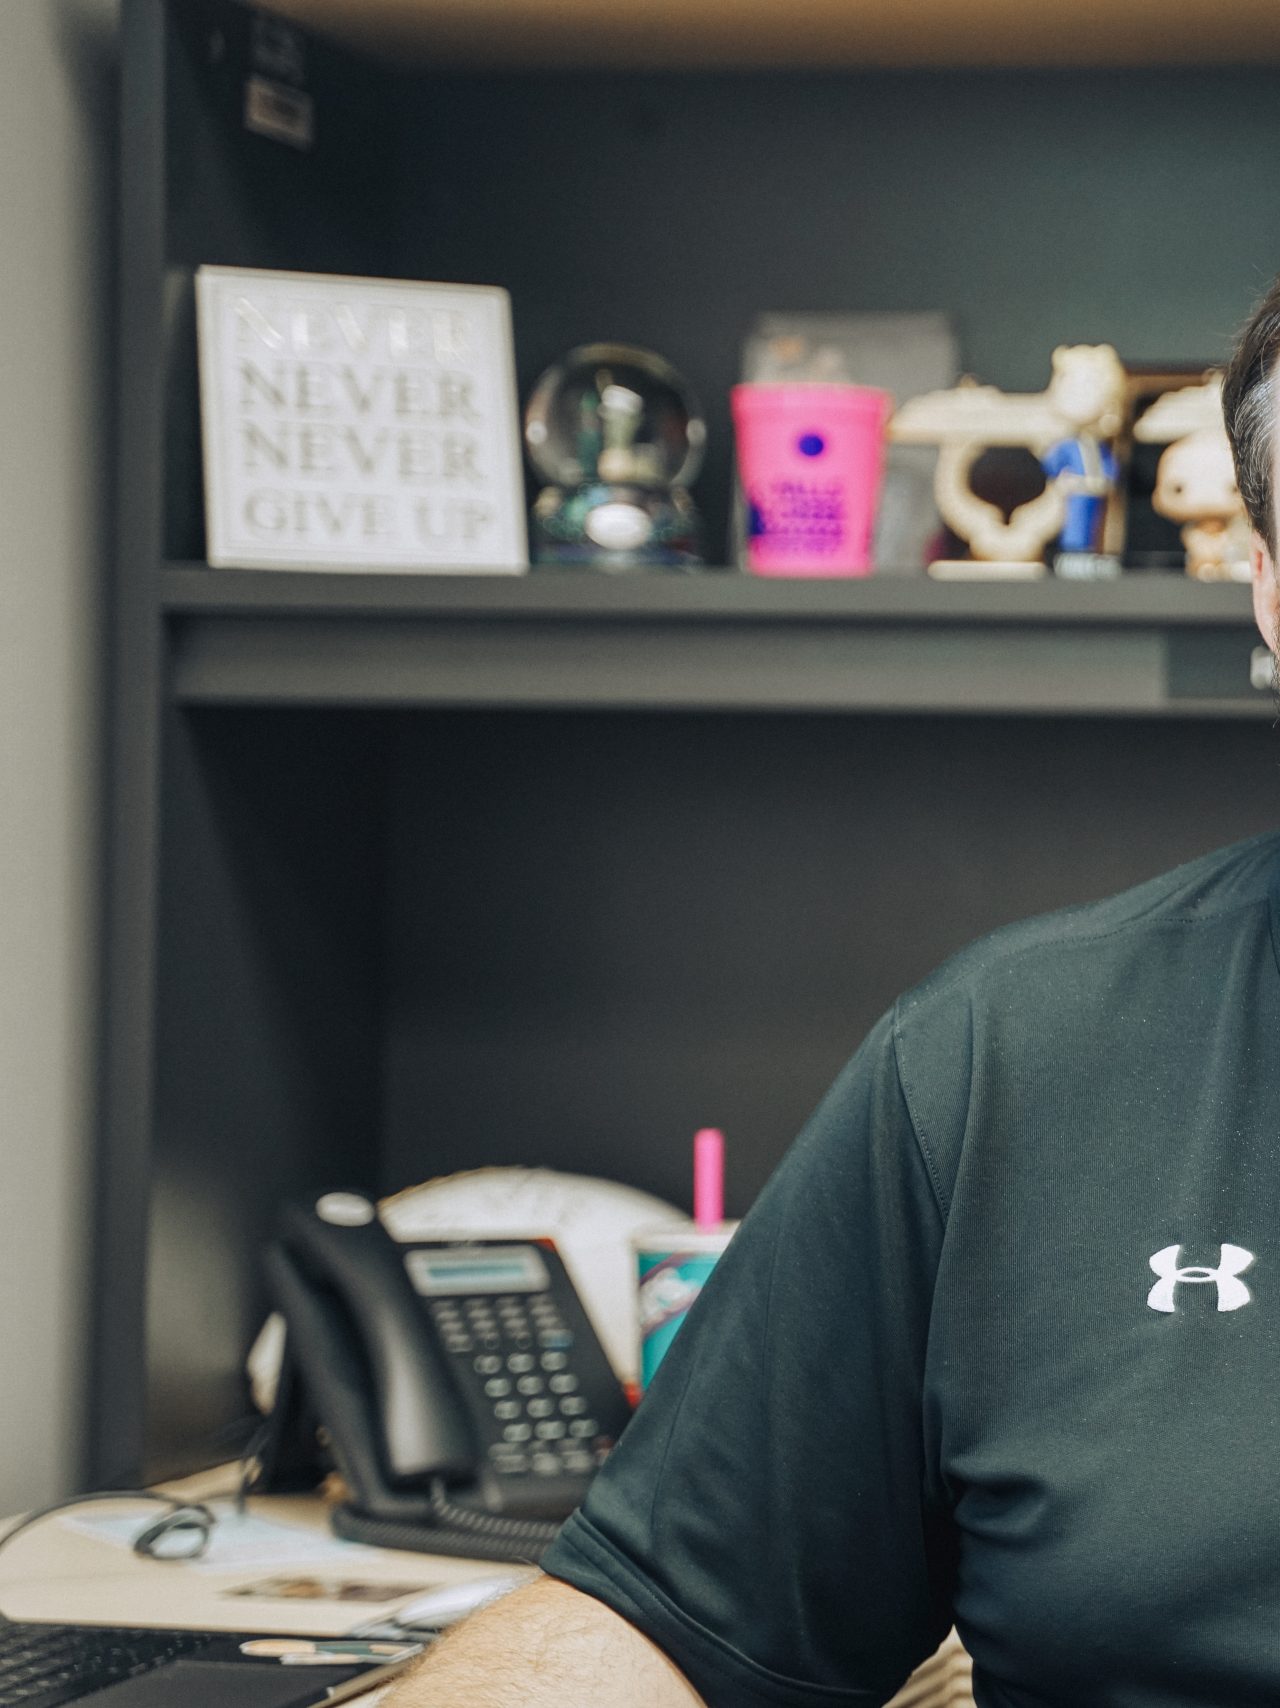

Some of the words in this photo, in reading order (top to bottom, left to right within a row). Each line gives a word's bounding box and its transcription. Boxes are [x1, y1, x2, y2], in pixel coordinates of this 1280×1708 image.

[239, 358, 482, 420] NEVER
[242, 420, 487, 481] NEVER
[241, 488, 394, 540] GIVE
[412, 494, 496, 546] UP
